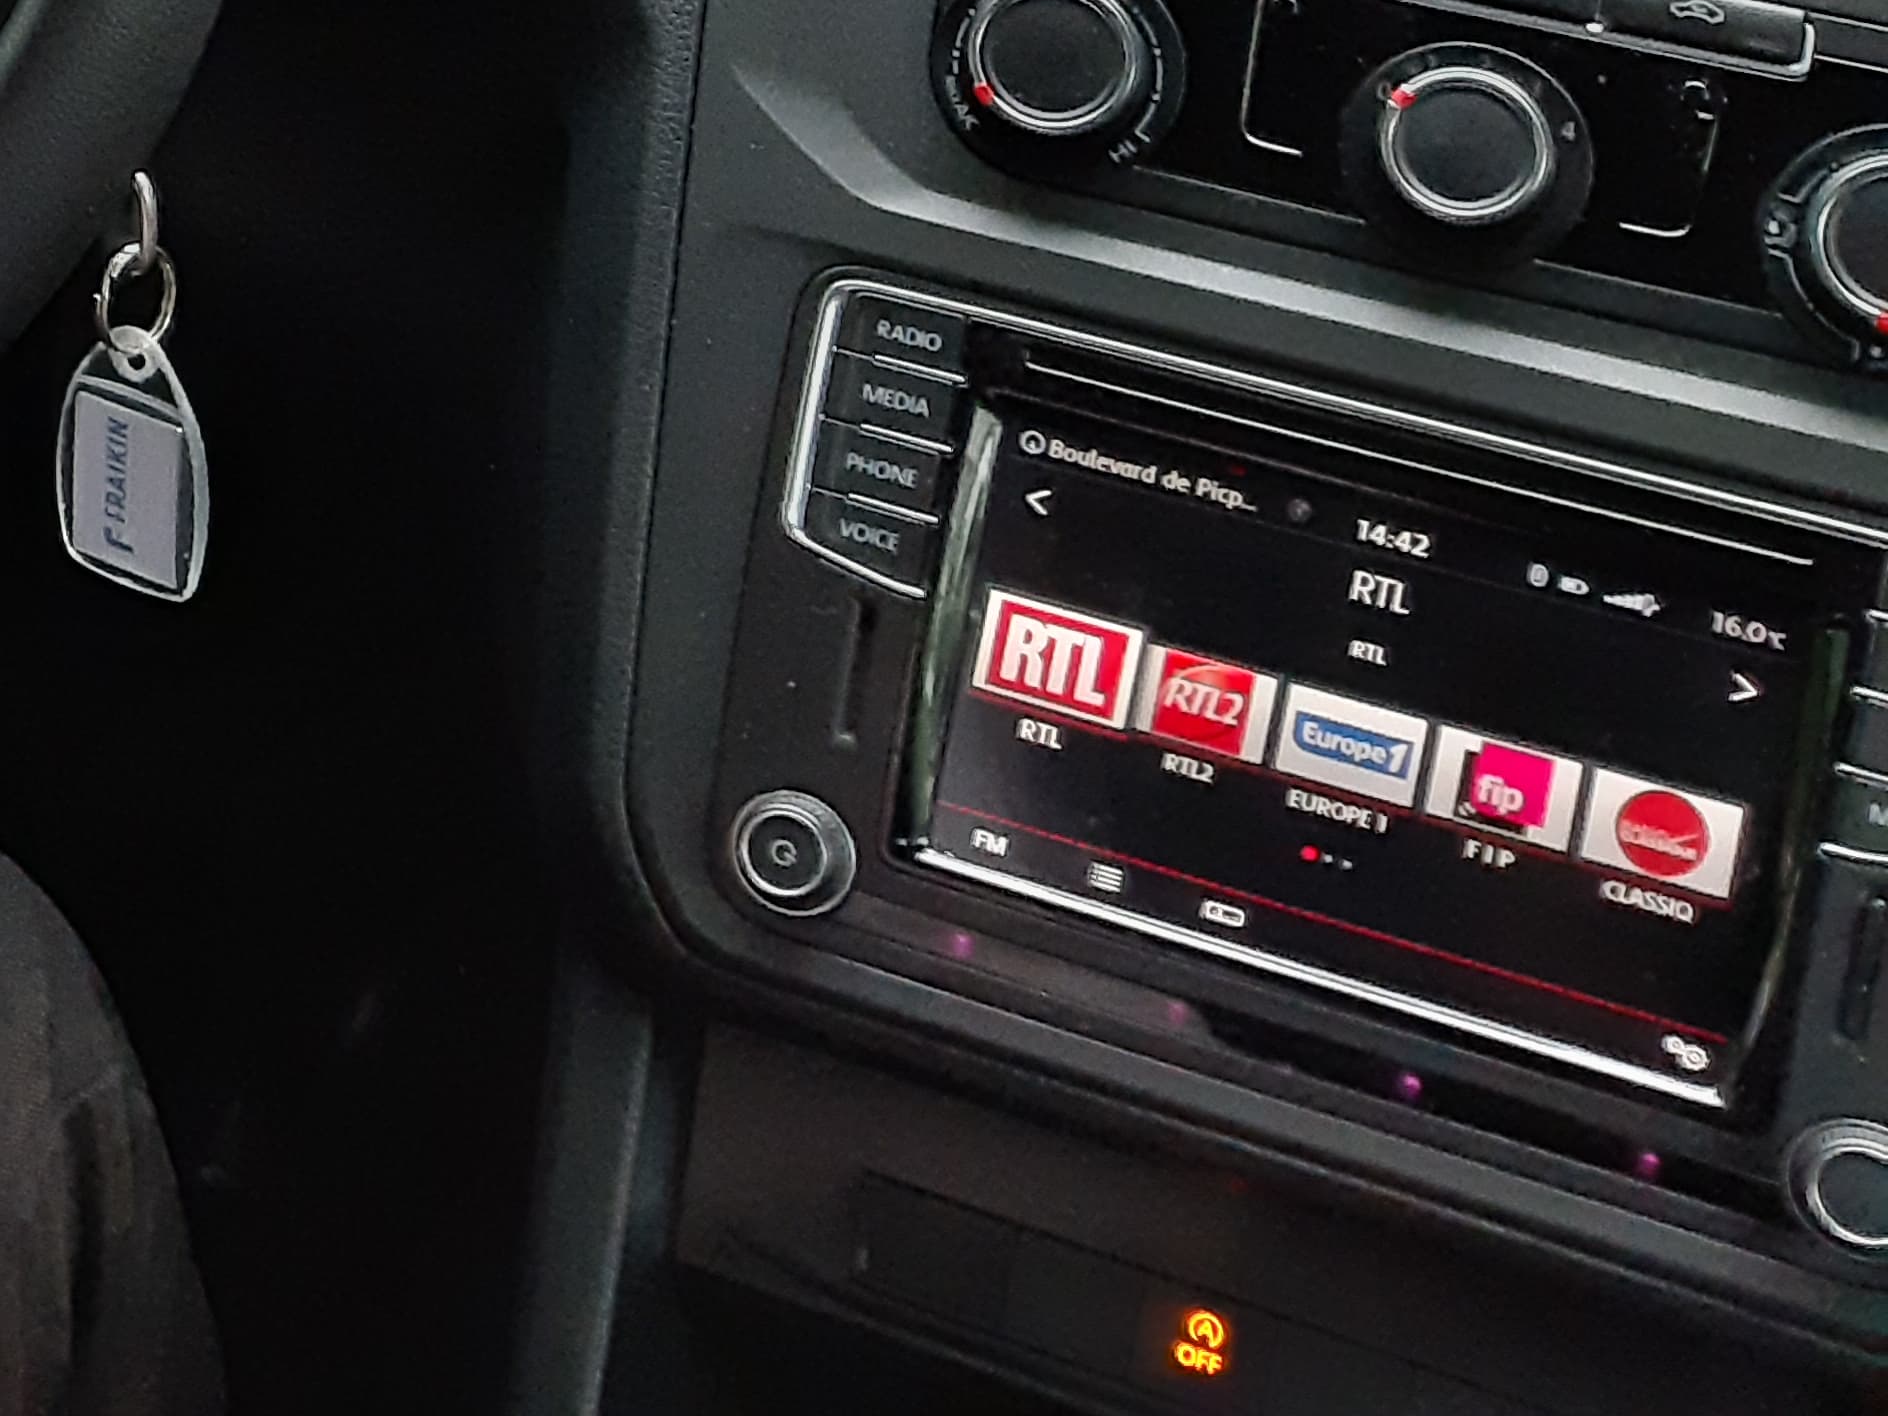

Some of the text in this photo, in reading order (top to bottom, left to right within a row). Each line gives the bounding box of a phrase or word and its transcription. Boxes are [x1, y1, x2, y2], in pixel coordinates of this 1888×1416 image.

[876, 319, 943, 352] RADIO
[862, 383, 931, 418] MEDIA
[105, 416, 129, 524] FRAIKIN
[846, 452, 920, 489] PHONE
[1047, 438, 1158, 485] Boulevard
[1160, 469, 1191, 494] de
[839, 518, 901, 555] VOICE
[1355, 518, 1432, 559] 14:42
[1347, 569, 1411, 616] RTL
[999, 613, 1106, 708] RTL
[1345, 639, 1388, 667] RTL
[1163, 676, 1244, 727] RTL2
[1016, 717, 1064, 751] RTL
[1160, 752, 1216, 785] RTL2
[1285, 787, 1374, 830] EUROPE
[1477, 773, 1524, 816] fip
[970, 827, 1011, 857] FM
[1601, 880, 1697, 926] CLASSIQ
[1174, 1342, 1223, 1376] OFF
